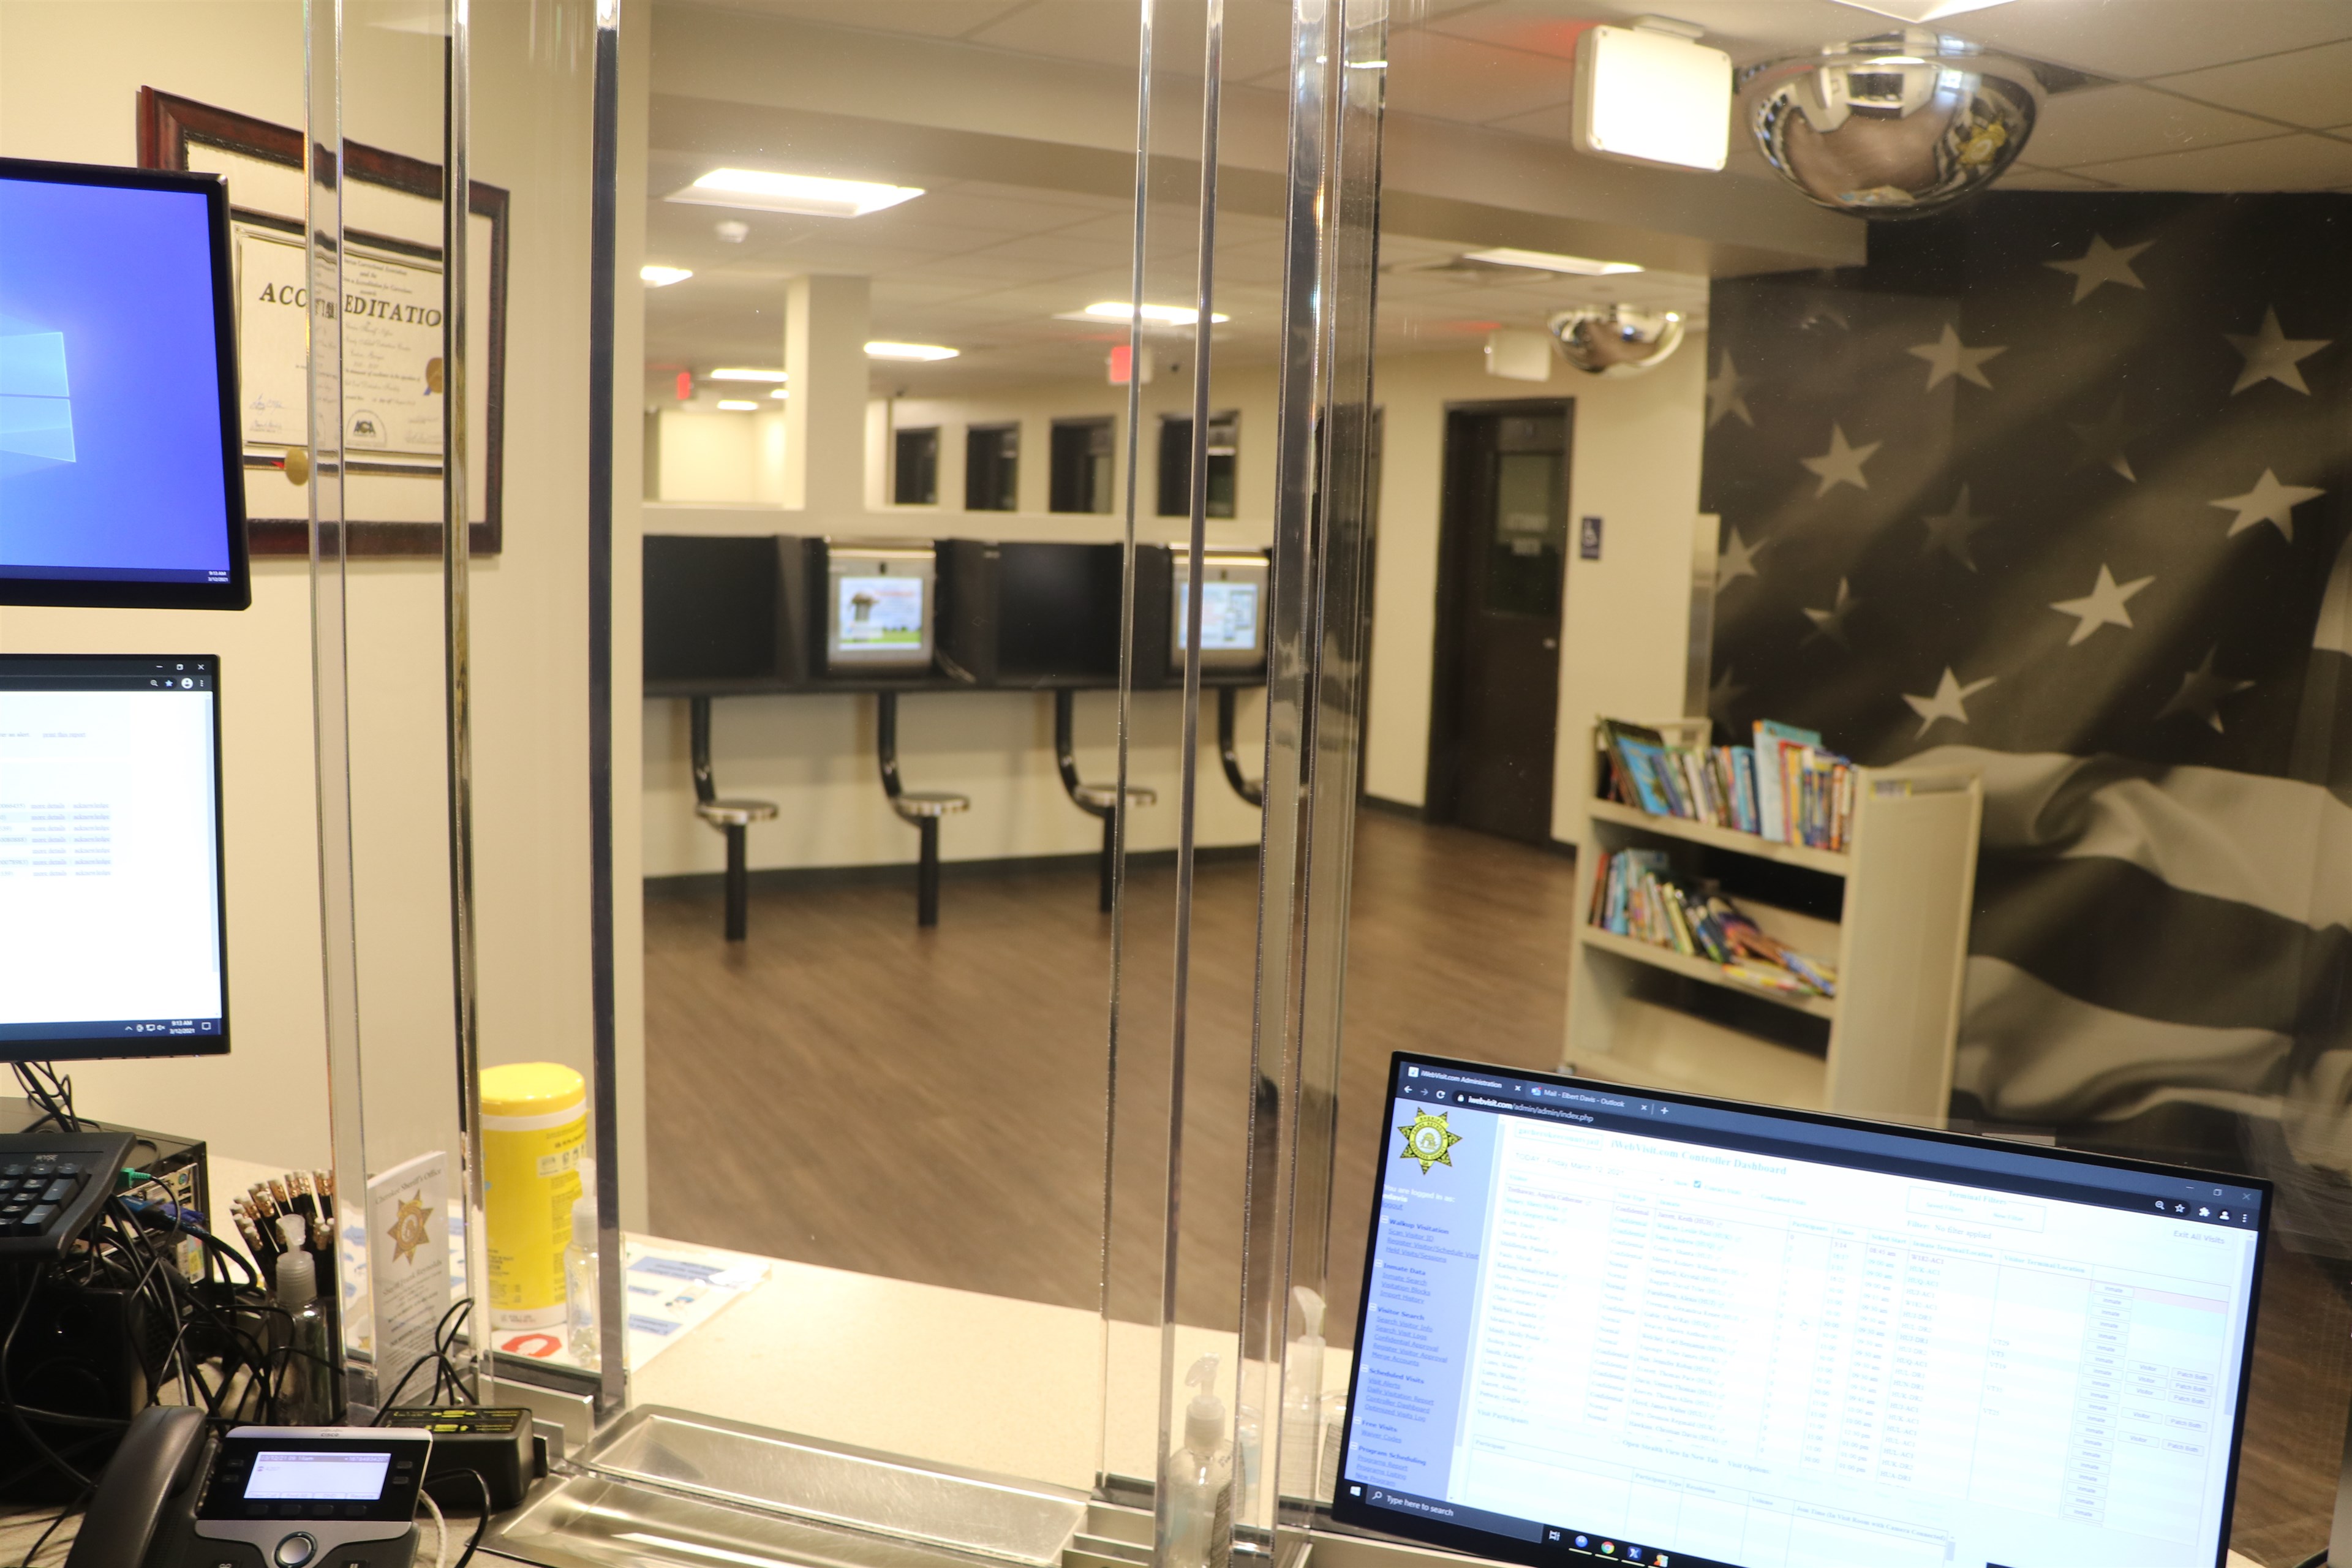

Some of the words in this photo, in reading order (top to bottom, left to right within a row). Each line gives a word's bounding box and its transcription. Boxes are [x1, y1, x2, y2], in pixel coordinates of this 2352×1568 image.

[1420, 1069, 1460, 1082] iWebVisit.com
[1460, 1076, 1502, 1088] Administration
[1562, 1091, 1578, 1100] Elbert
[1579, 1094, 1595, 1102] Davis
[1600, 1098, 1624, 1107] Outlook
[1468, 1095, 1594, 1123] iwebvisit.com/admin/admin/index.php
[1611, 1139, 1678, 1158] iWebVisit.com
[1681, 1150, 1730, 1167] Controller
[1733, 1159, 1786, 1175] Dashboard
[1389, 1219, 1414, 1229] Walkup
[1416, 1223, 1449, 1234] Visitation
[2173, 1230, 2188, 1238] Exit
[2190, 1232, 2201, 1241] All
[2204, 1235, 2225, 1245] Visits
[1384, 1263, 1408, 1272] Inmate
[1382, 1272, 1404, 1282] Inmate
[1406, 1276, 1427, 1286] Search
[1381, 1281, 1409, 1292] Visitation
[1410, 1286, 1431, 1296] Blocks
[1378, 1306, 1400, 1316] Visitor
[1401, 1311, 1424, 1321] Search
[1369, 1368, 1404, 1380] Scheduled
[1405, 1375, 1424, 1384] Visits
[1378, 1423, 1397, 1432] Visits
[1358, 1446, 1387, 1457] Program
[1389, 1452, 1426, 1466] Scheduling
[1386, 1495, 1403, 1506] Type
[1404, 1499, 1420, 1509] here
[1430, 1505, 1454, 1517] search
